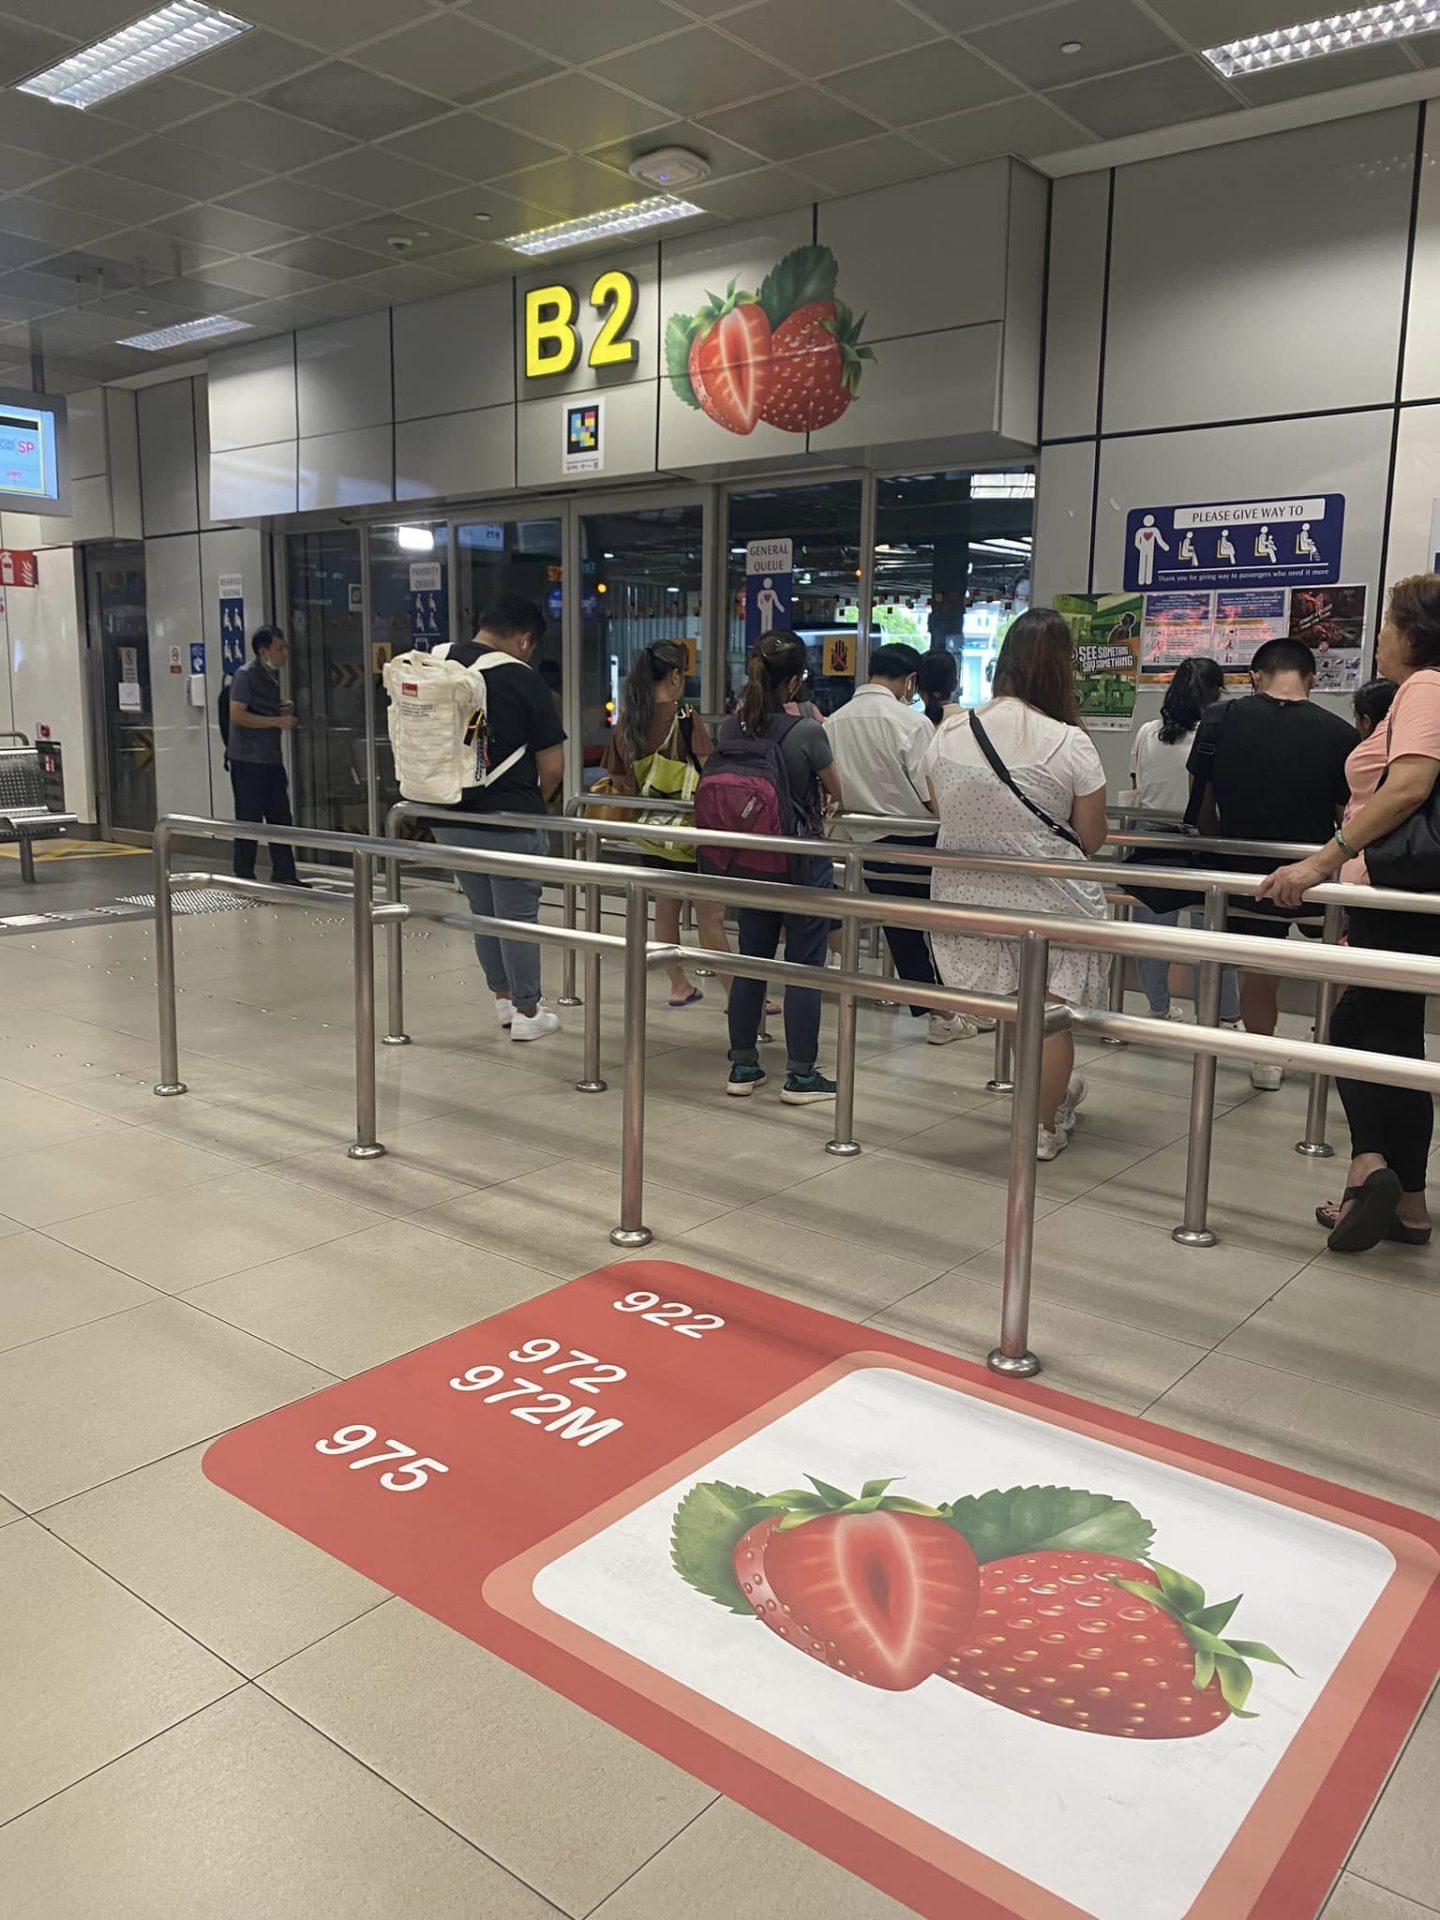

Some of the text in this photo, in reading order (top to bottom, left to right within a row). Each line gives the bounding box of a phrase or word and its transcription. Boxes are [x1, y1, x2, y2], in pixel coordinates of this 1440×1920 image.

[525, 270, 640, 378] B2
[18, 440, 35, 453] SP
[1192, 505, 1304, 523] PLEASE GIVE WAY TO
[749, 545, 788, 557] GENERAL
[411, 566, 439, 577] PRIORITY
[753, 560, 785, 572] QUEUE
[1177, 575, 1188, 583] you
[1199, 574, 1216, 582] giving
[1218, 573, 1229, 581] way
[1239, 571, 1272, 580] passengers
[1079, 645, 1128, 661] SEE SOMETHING
[1082, 655, 1133, 673] SAY SOMETHING
[613, 1290, 726, 1339] 922
[508, 1337, 628, 1394] 972
[449, 1365, 624, 1448] 972M
[315, 1424, 450, 1492] 975
